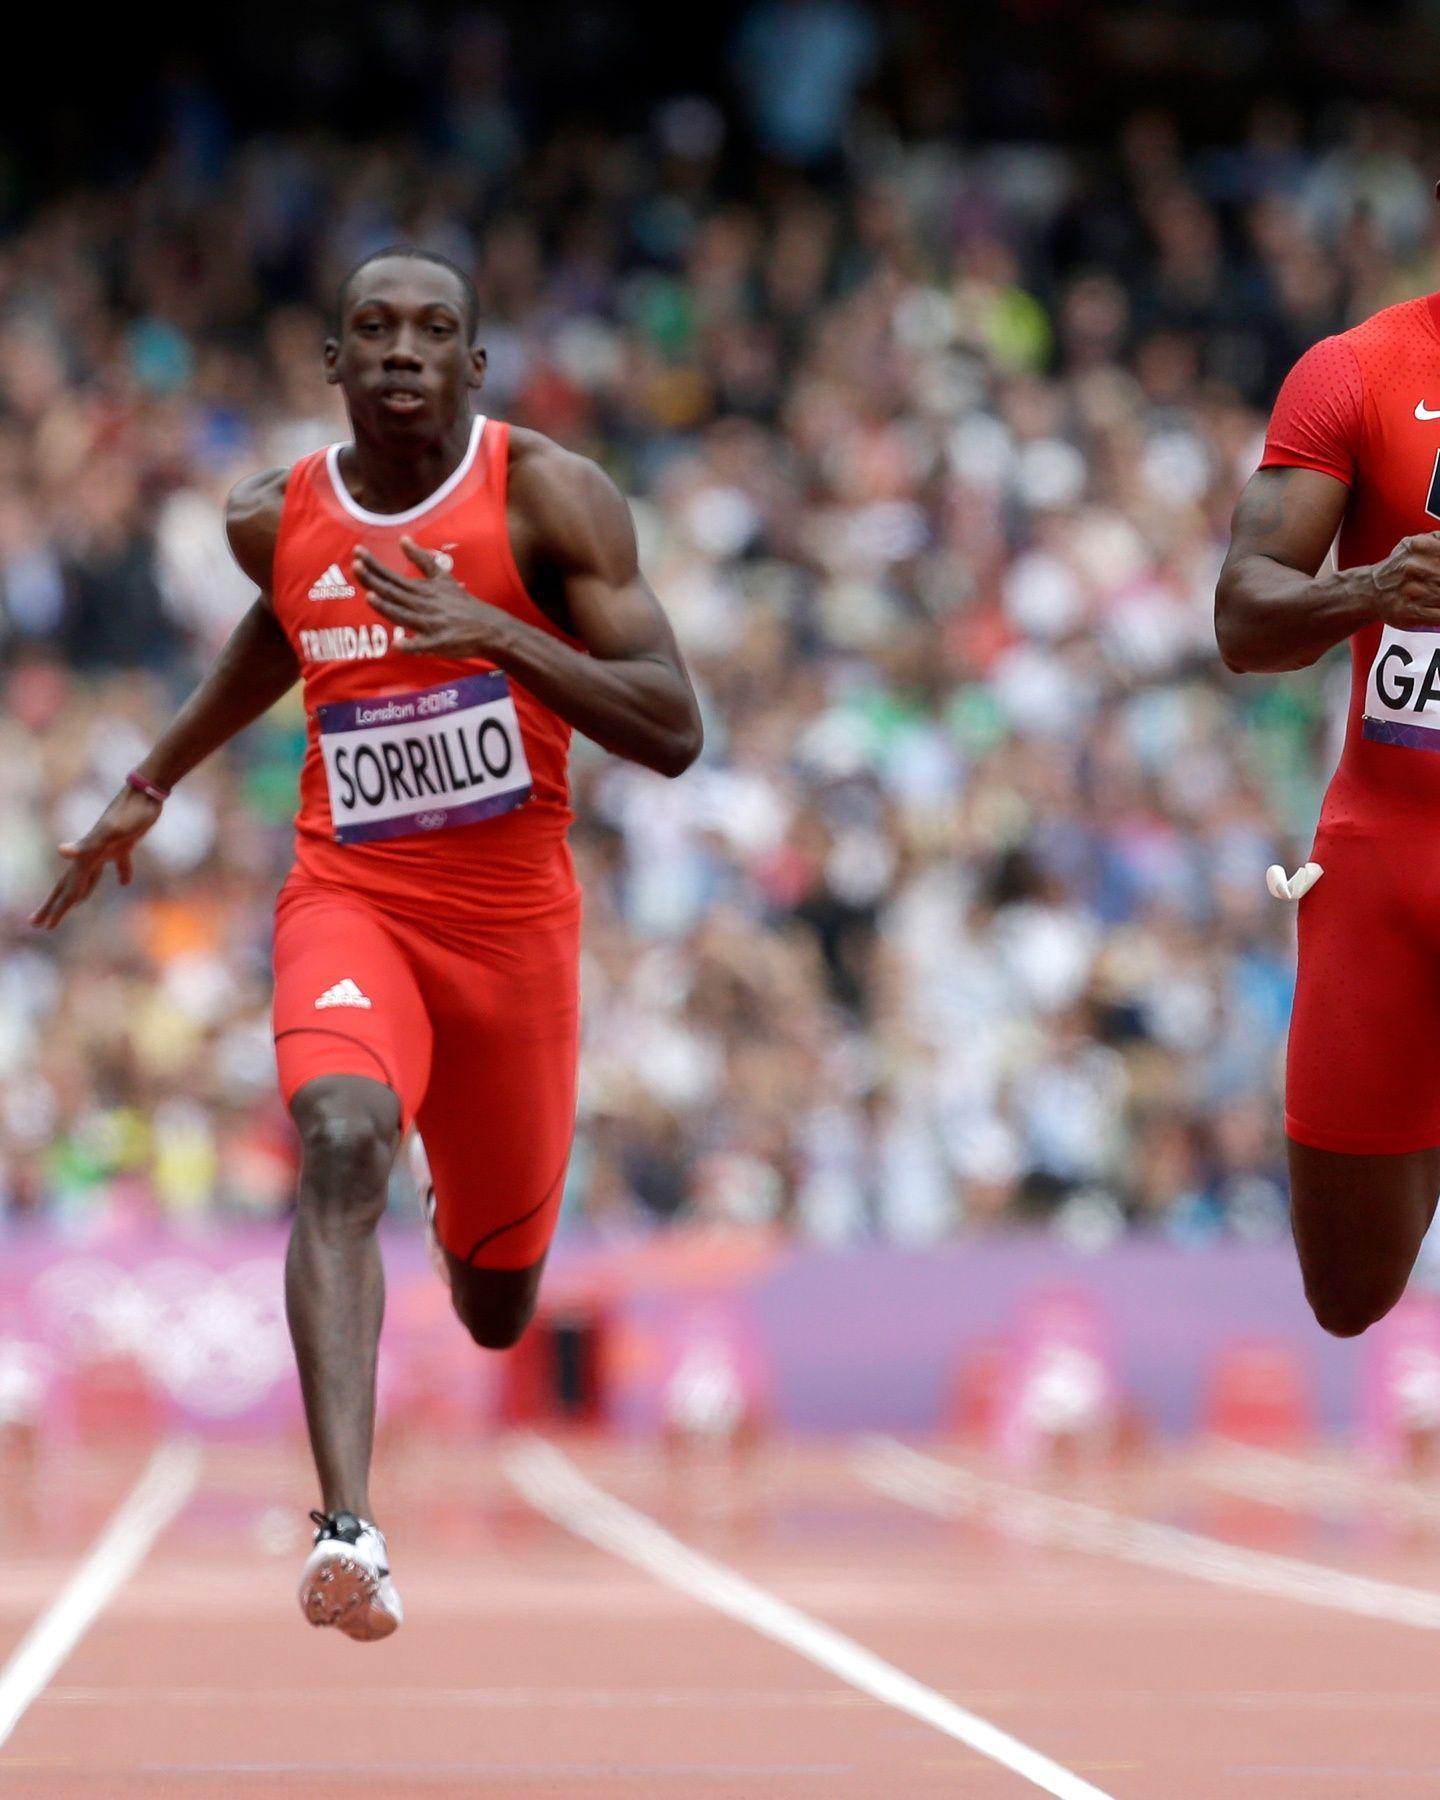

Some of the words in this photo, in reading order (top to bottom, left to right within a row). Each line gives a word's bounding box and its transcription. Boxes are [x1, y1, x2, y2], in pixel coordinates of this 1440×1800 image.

[299, 624, 388, 662] TRINIDAD
[355, 702, 414, 726] London
[417, 690, 459, 714] 2012
[335, 718, 512, 809] SORRILLO
